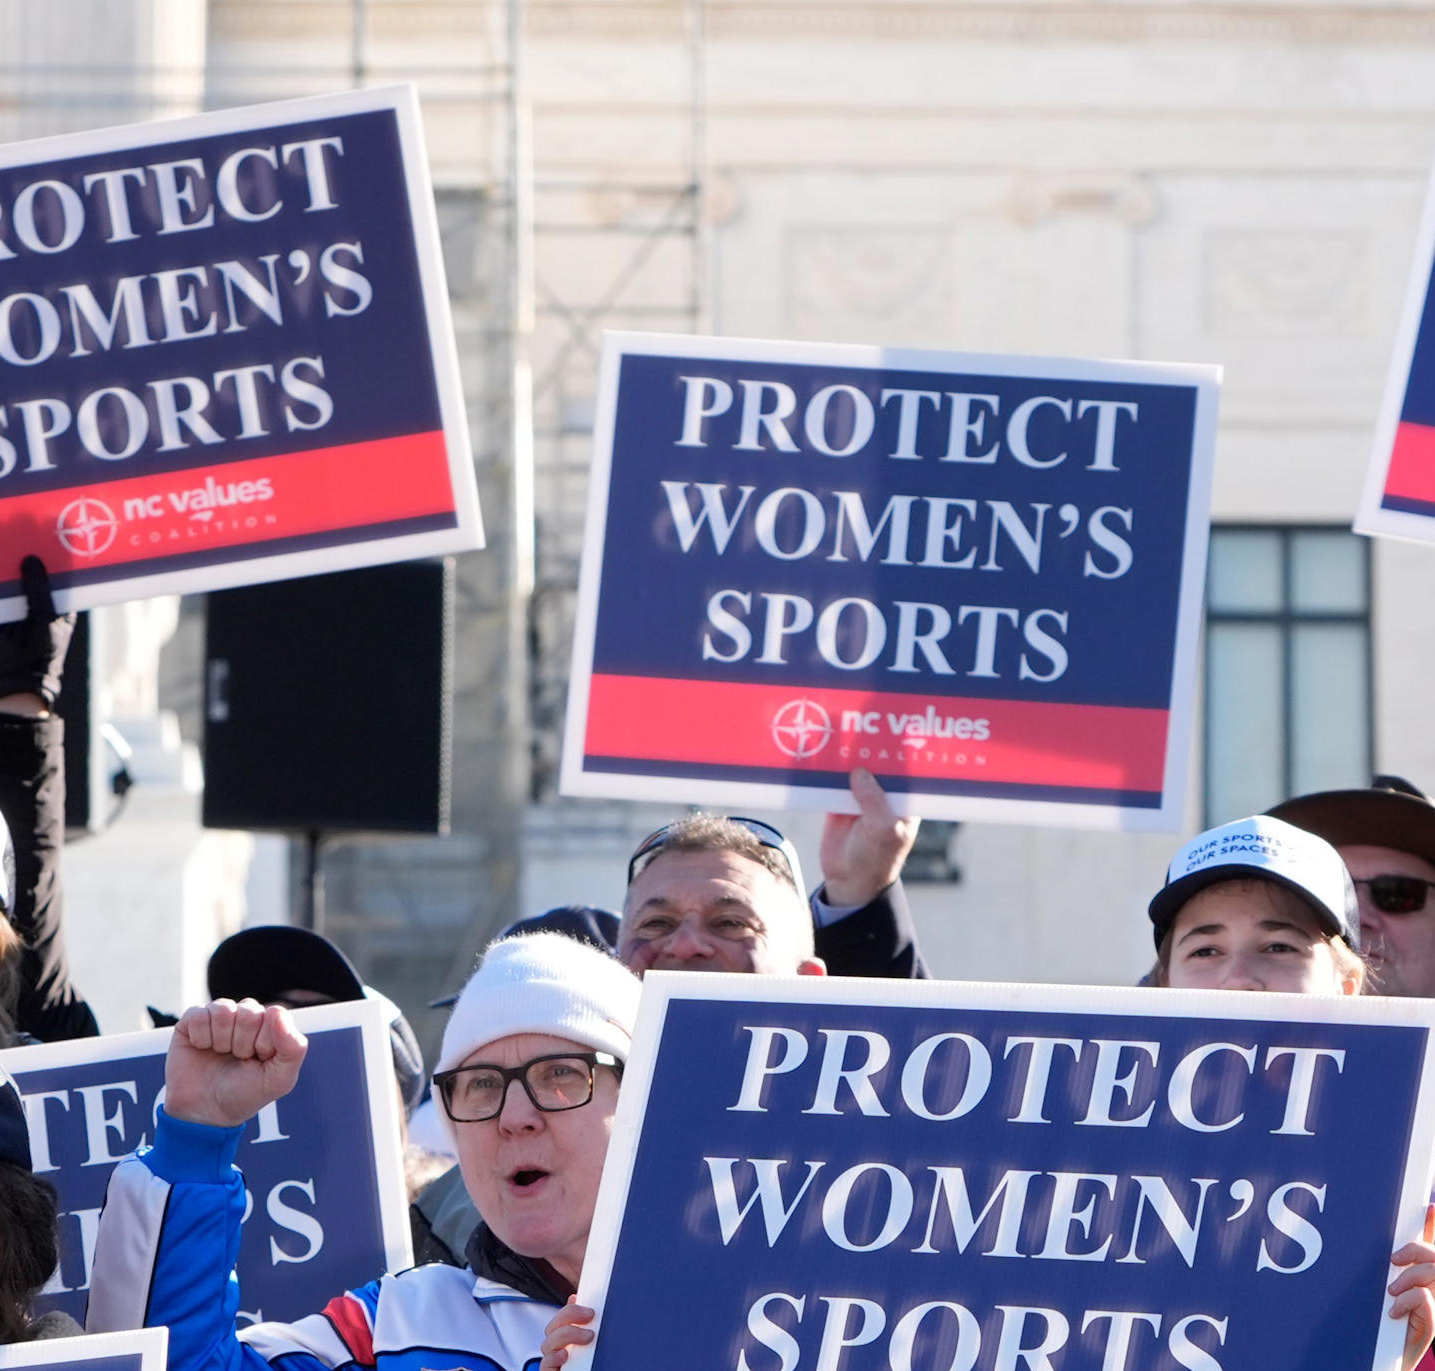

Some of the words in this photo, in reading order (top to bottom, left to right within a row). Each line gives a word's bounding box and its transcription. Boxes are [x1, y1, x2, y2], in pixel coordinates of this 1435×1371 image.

[674, 376, 1138, 471] PROTECT
[124, 495, 164, 521] nc
[170, 477, 273, 511] values
[661, 481, 1134, 579] WOMEN'S
[702, 588, 1069, 682] SPORTS
[841, 709, 879, 734] nc
[887, 706, 989, 740] values
[1186, 851, 1215, 871] OUR
[1220, 844, 1278, 857] SPACES
[1188, 839, 1217, 859] OUR
[1222, 834, 1282, 847] SPORTS
[727, 1024, 1346, 1137] PROTECT
[703, 1156, 1328, 1275] WOMEN'S
